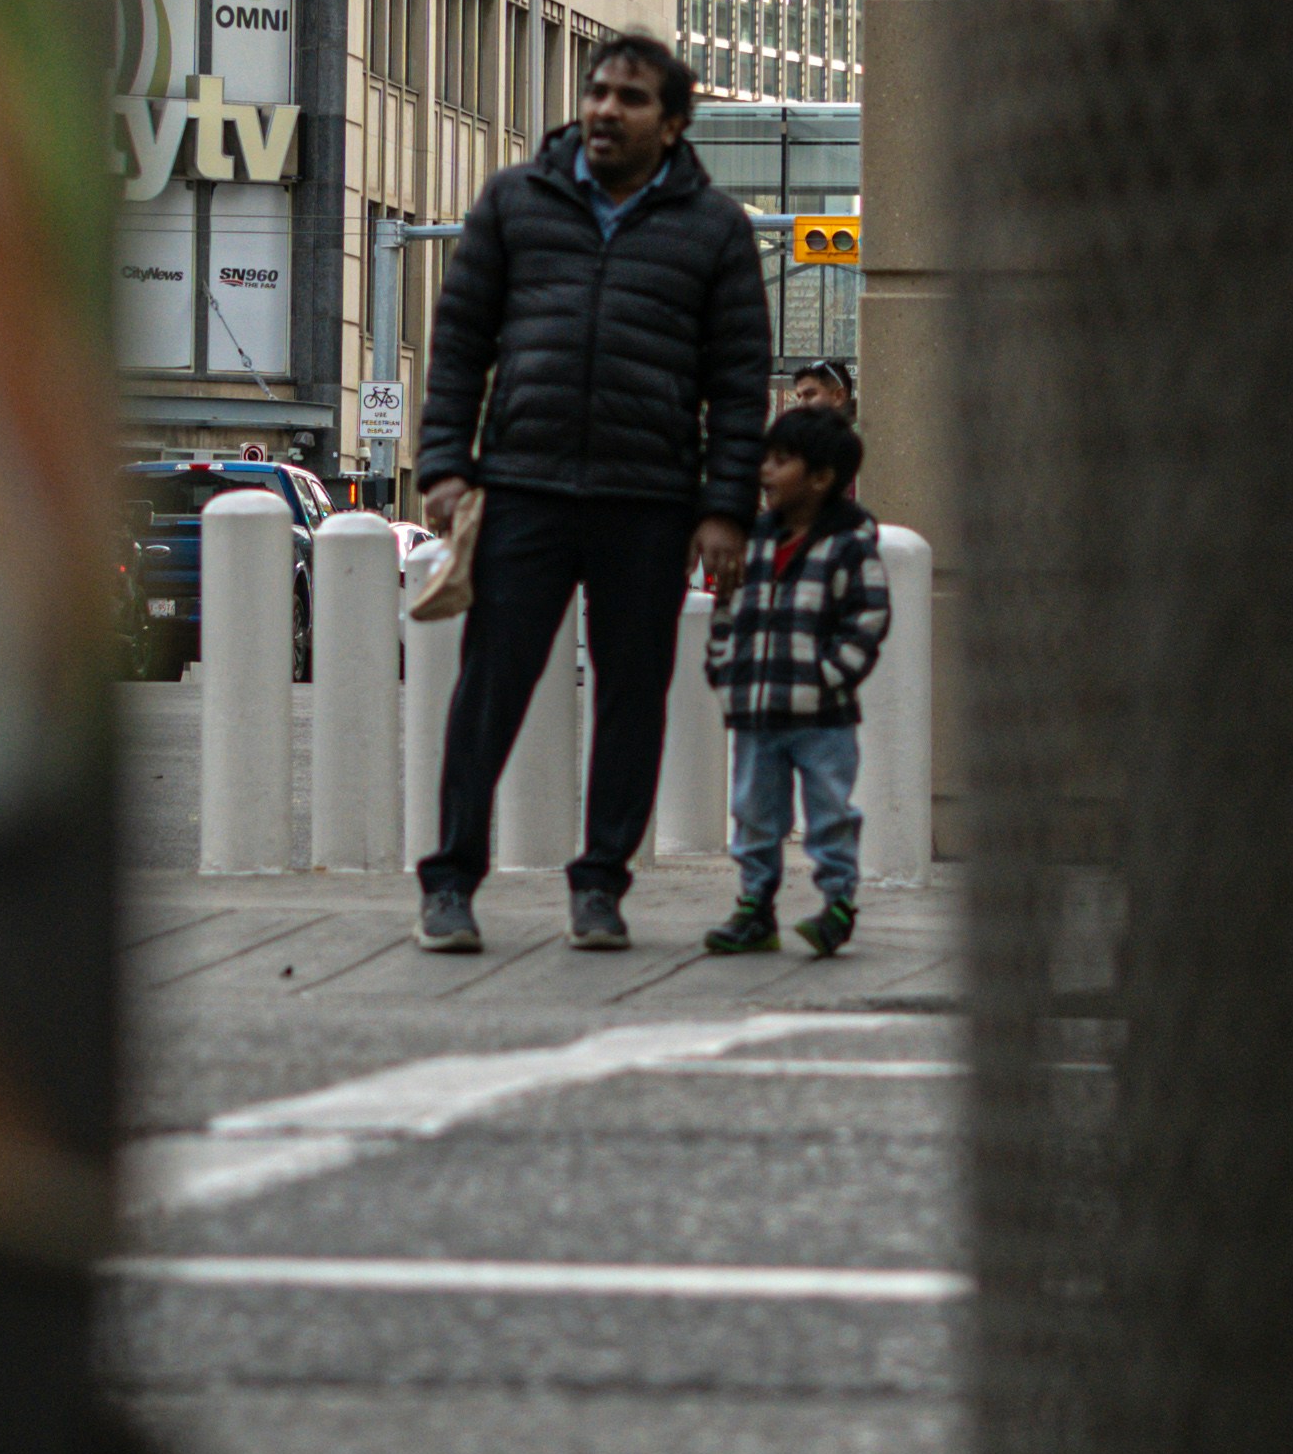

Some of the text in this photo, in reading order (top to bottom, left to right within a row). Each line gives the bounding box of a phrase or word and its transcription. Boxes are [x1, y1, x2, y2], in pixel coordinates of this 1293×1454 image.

[215, 4, 288, 32] OMNI
[111, 74, 301, 201] ytv
[121, 265, 184, 282] CityNews
[219, 267, 279, 282] SN960
